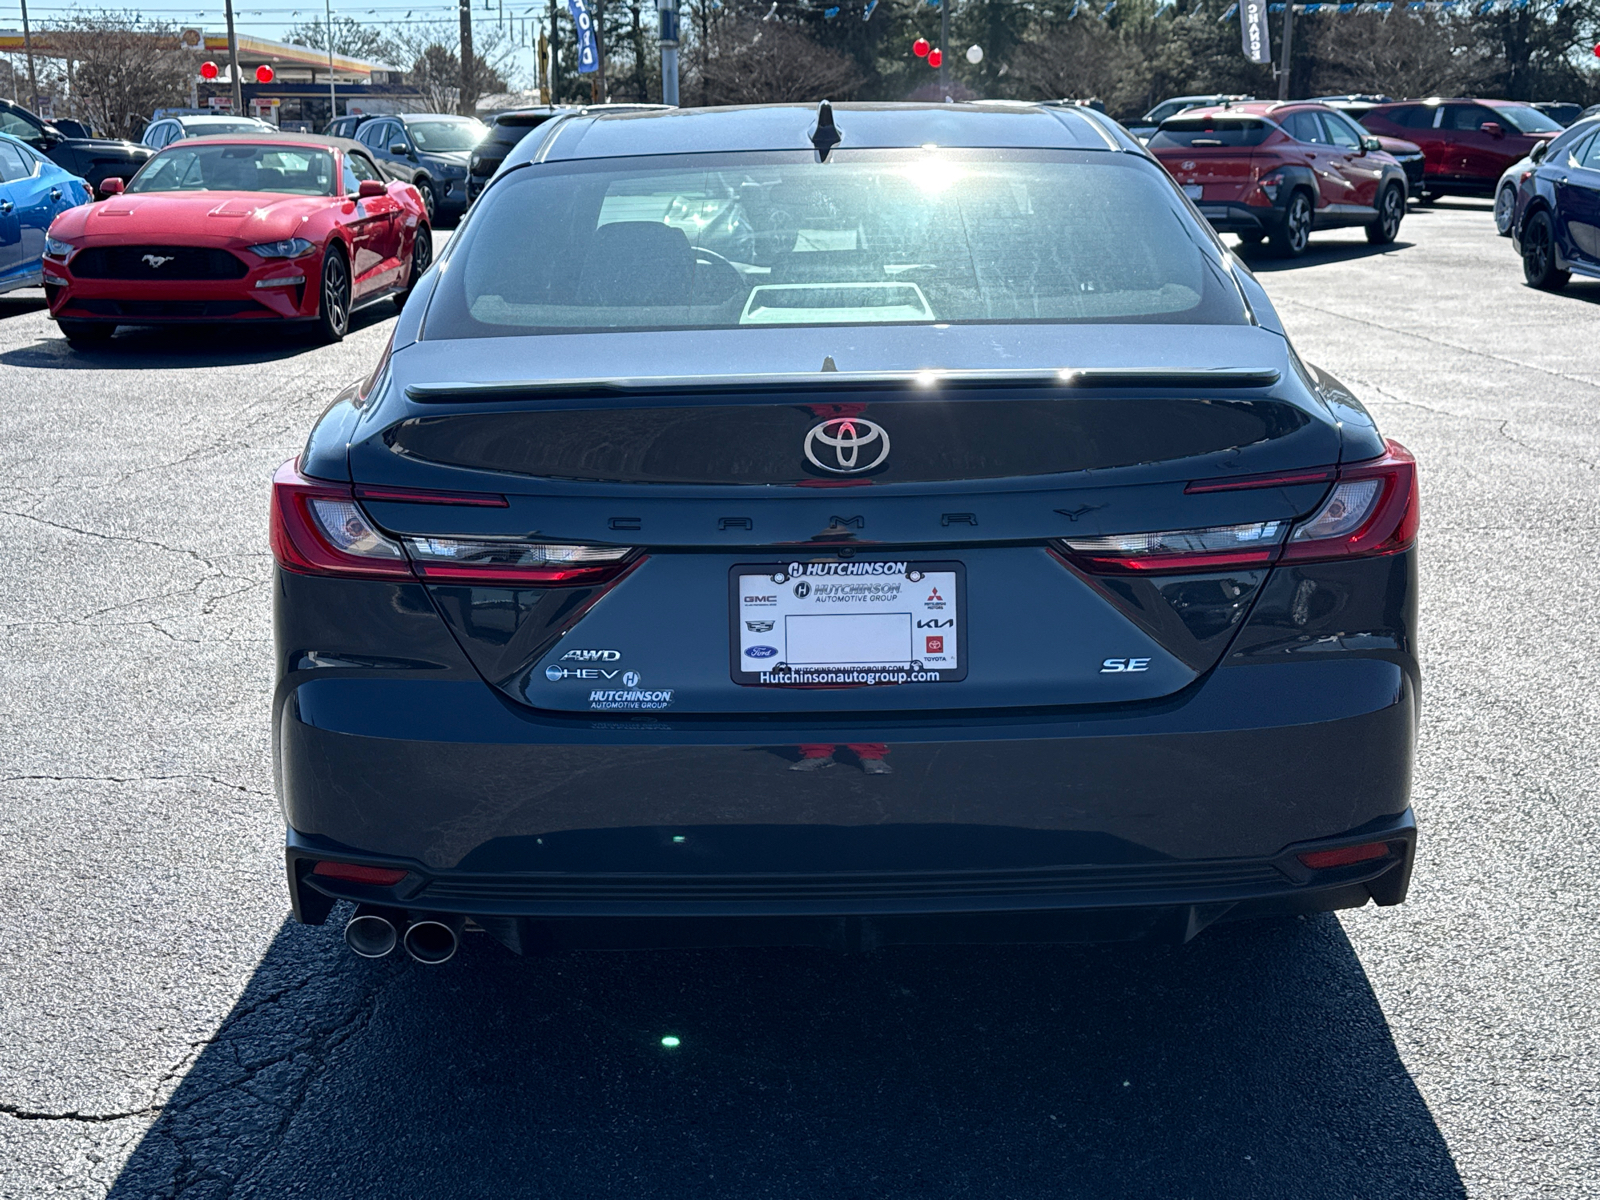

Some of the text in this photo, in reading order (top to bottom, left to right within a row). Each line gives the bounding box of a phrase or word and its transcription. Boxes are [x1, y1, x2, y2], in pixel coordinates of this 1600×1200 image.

[607, 507, 1095, 531] CAMRY
[806, 562, 908, 576] HUTCHINSON
[814, 583, 902, 595] HUTCHINSON
[744, 595, 777, 603] GMC
[815, 594, 898, 603] AUTOMOTIVE GROUP
[560, 650, 621, 661] AWD
[750, 647, 771, 657] Ford
[1100, 657, 1152, 673] SE
[562, 669, 620, 679] HEV
[759, 670, 940, 685] Hutchinsonautogroup.com
[589, 691, 671, 701] HUTCHINSON
